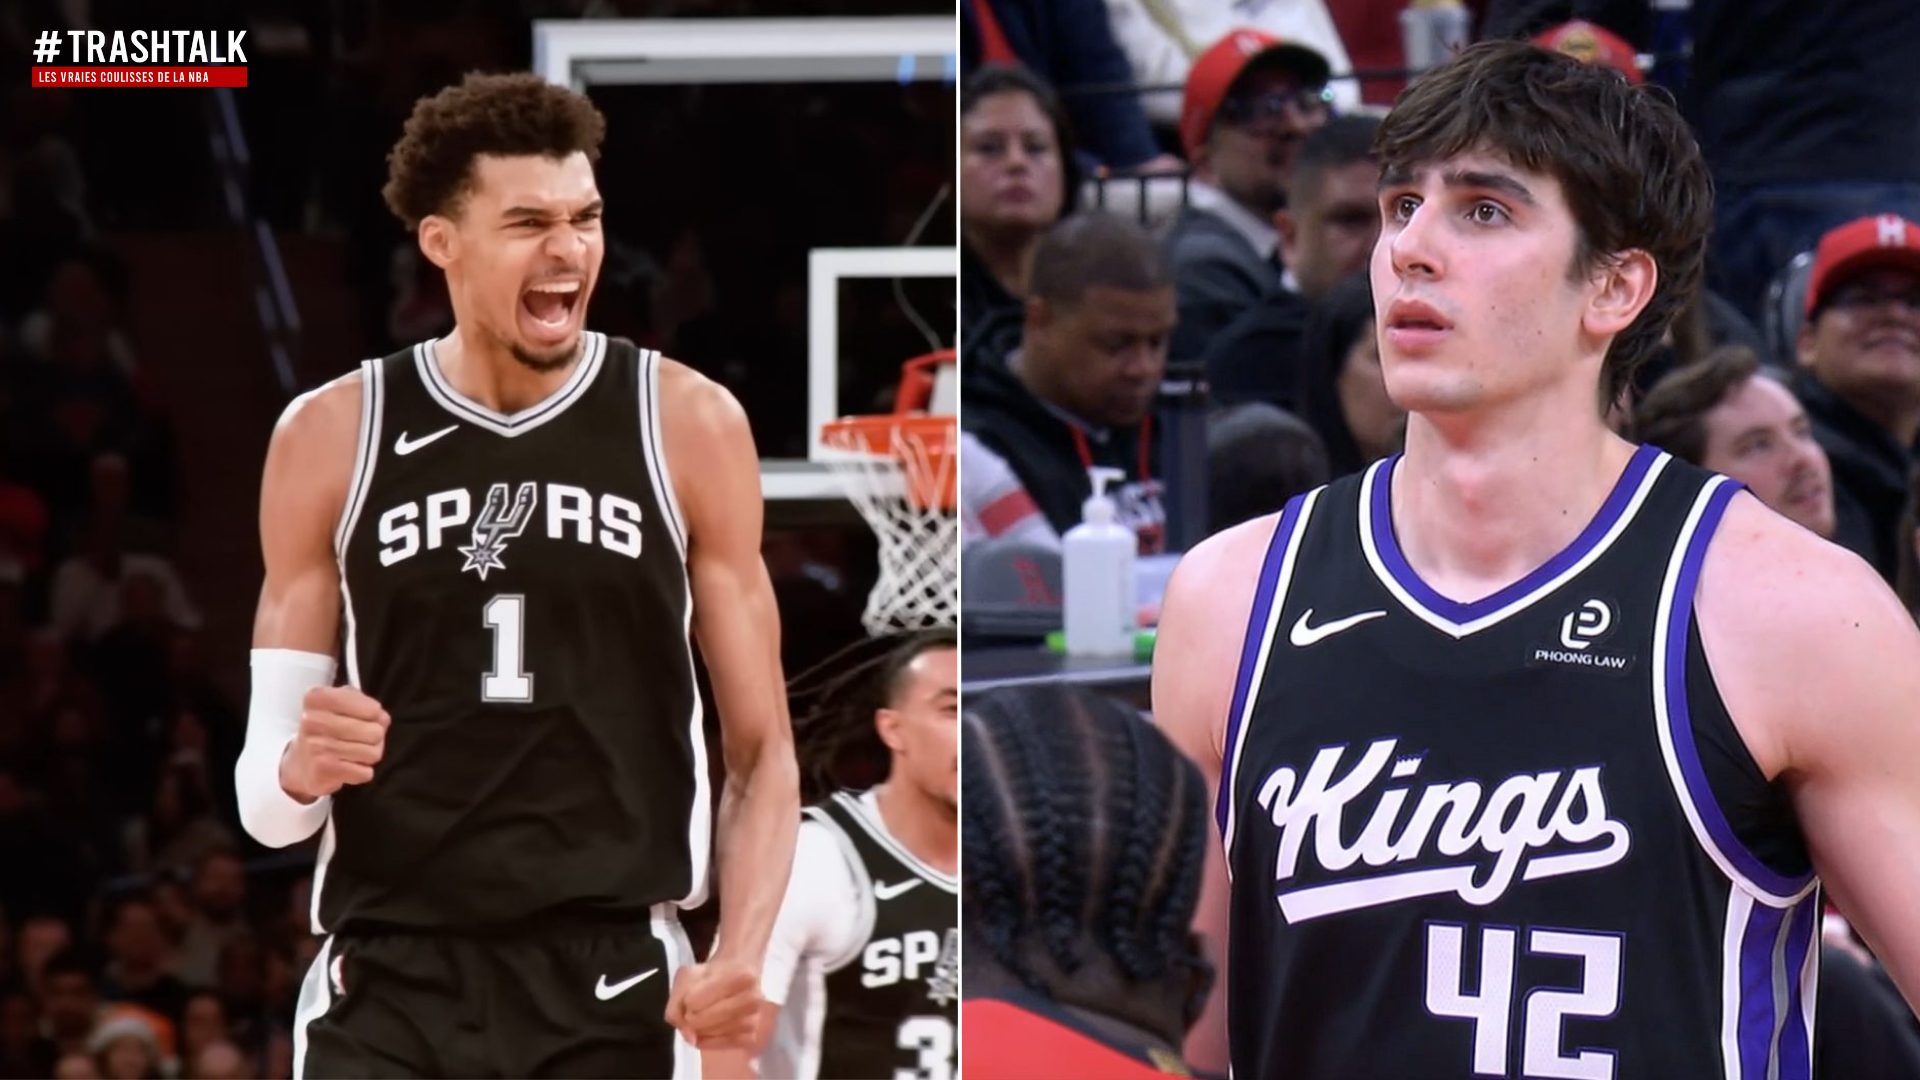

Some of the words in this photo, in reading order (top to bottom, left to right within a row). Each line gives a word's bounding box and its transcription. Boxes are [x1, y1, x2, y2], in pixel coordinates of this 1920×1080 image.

[1877, 215, 1906, 246] H
[378, 482, 643, 581] SPURS
[481, 593, 534, 704] 1
[1535, 650, 1592, 665] PHOONG
[1594, 655, 1626, 668] LAW
[1257, 738, 1630, 925] Kings
[1424, 923, 1625, 1080] 42
